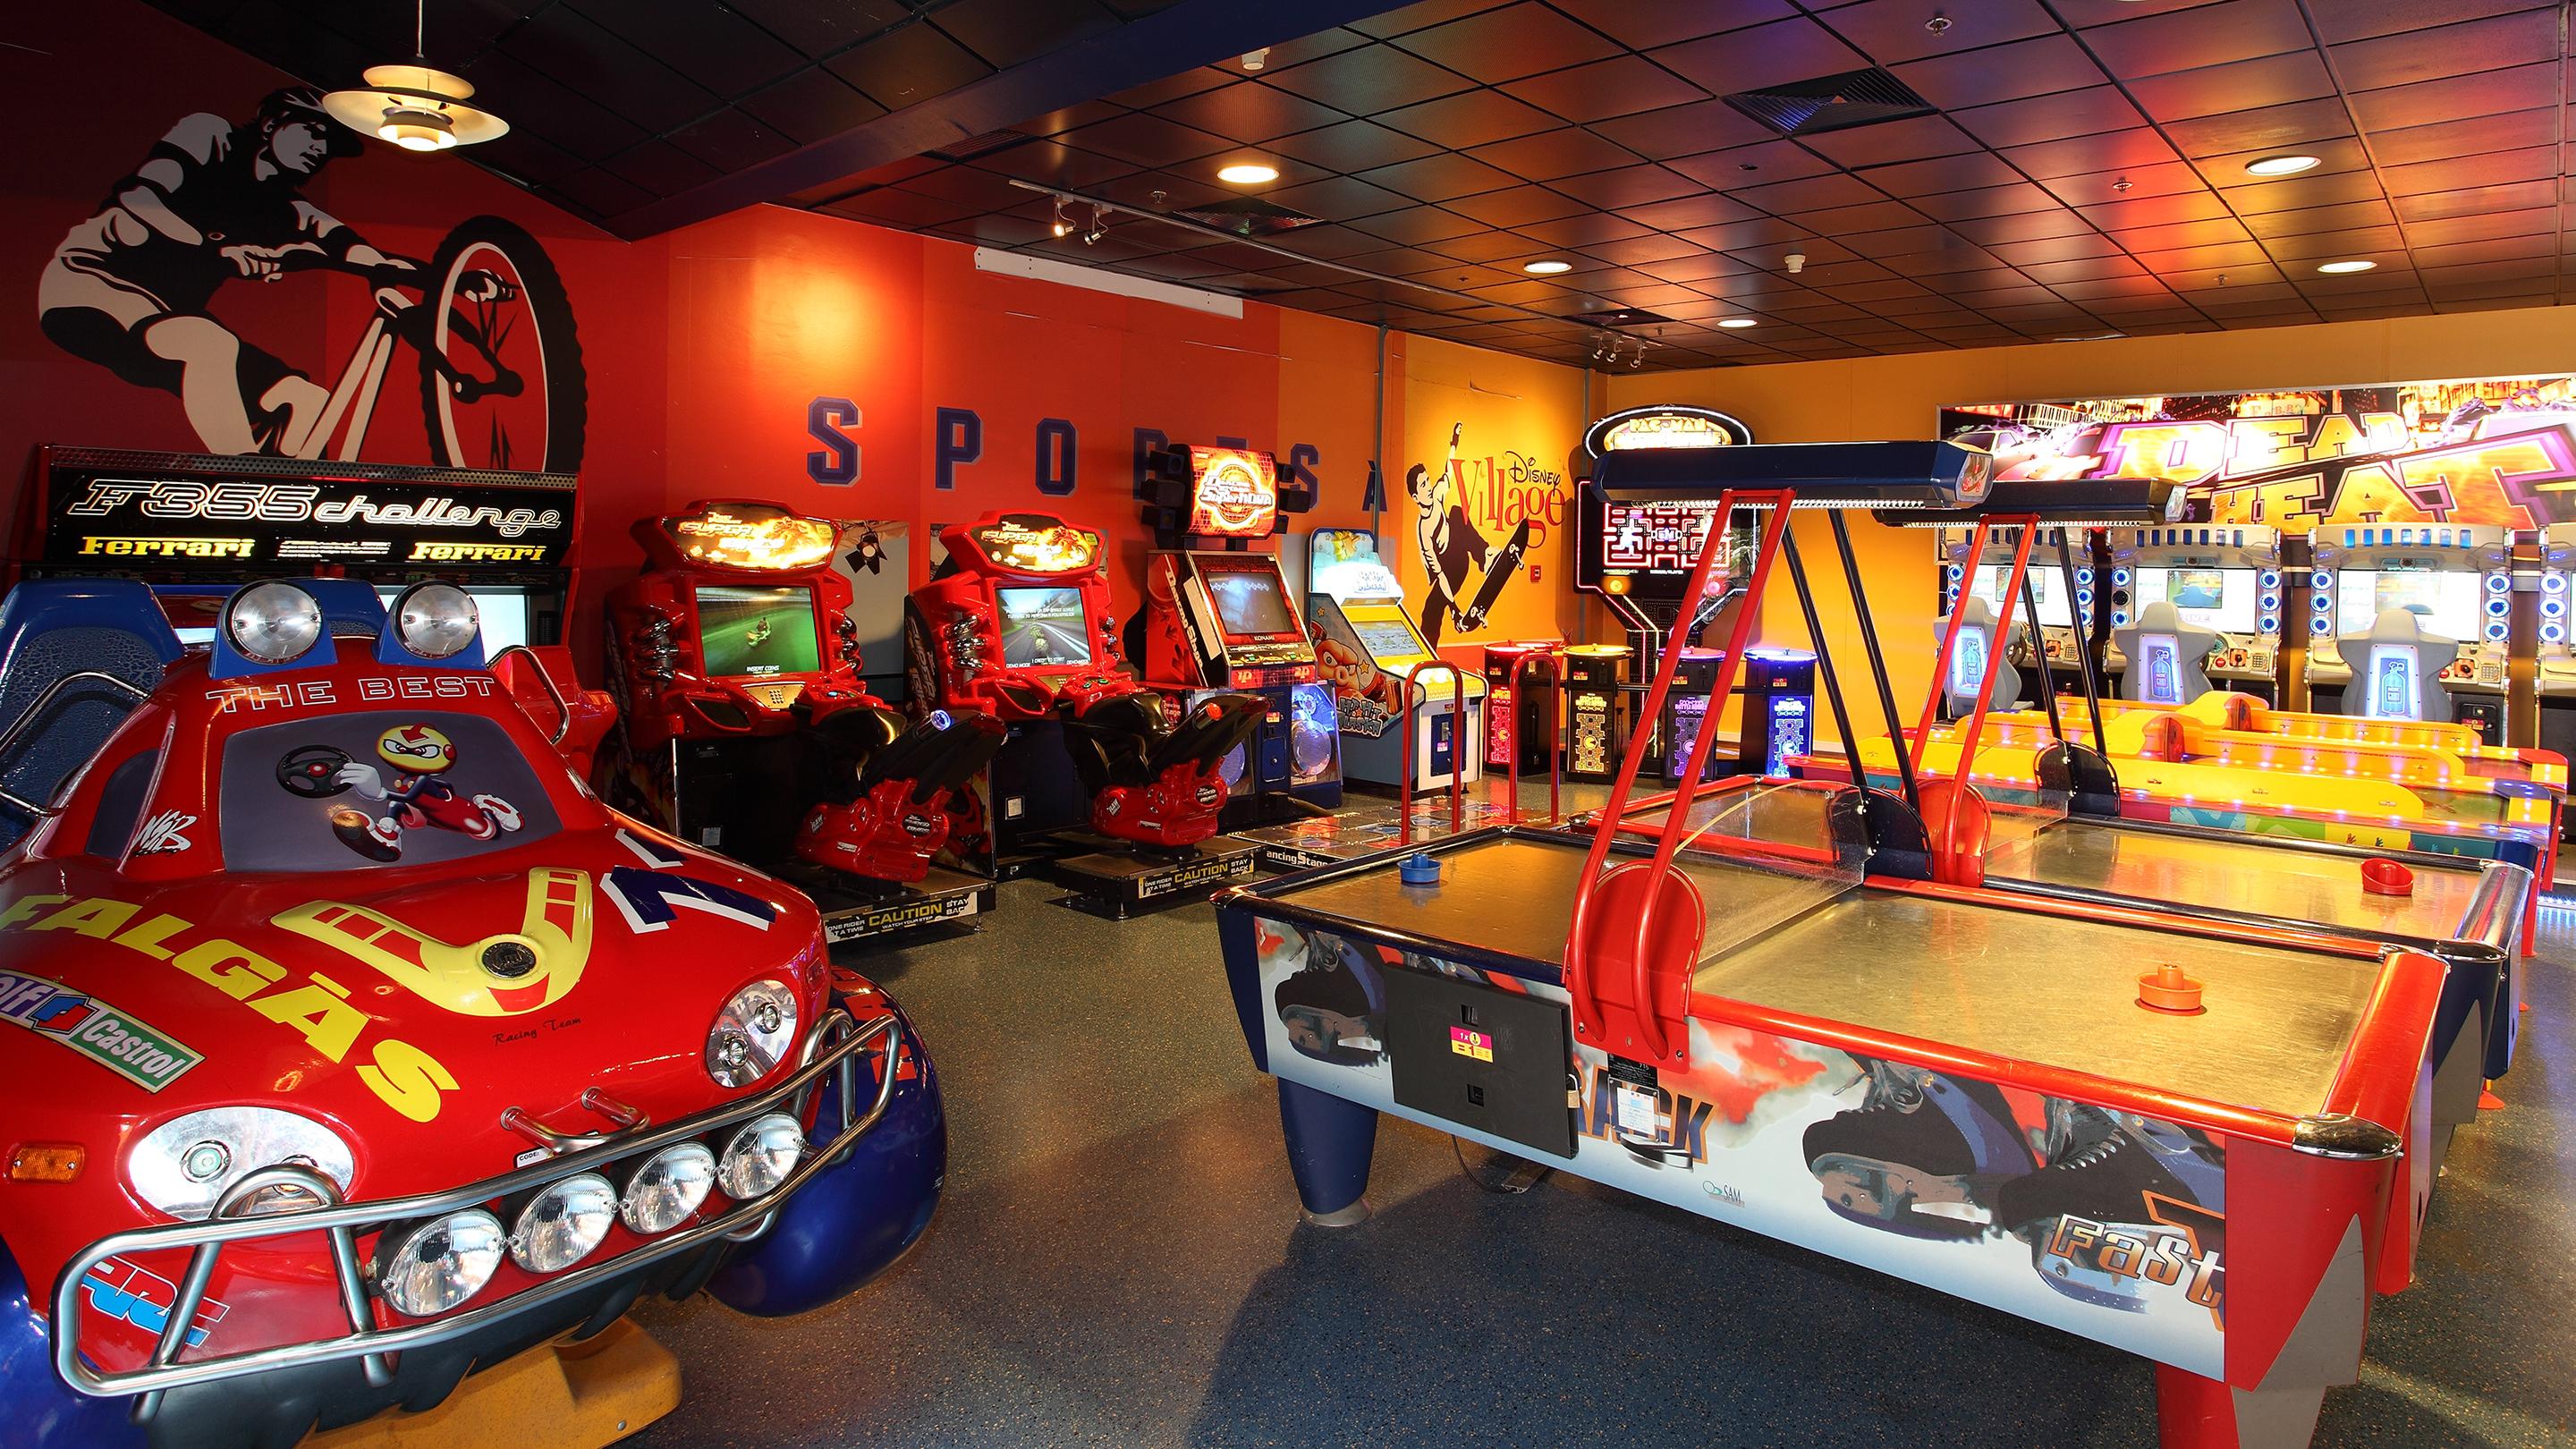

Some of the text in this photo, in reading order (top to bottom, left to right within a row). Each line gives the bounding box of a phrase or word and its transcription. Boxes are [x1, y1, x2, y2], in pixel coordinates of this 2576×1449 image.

[1629, 418, 1707, 432] PAC-MAN
[808, 396, 1320, 512] SPORS
[2100, 412, 2412, 487] DEAD
[1450, 456, 1566, 548] Village
[314, 495, 562, 537] challenge
[79, 537, 257, 557] Ferrari
[408, 542, 547, 562] Ferrari
[205, 676, 496, 714] THE BEST
[1174, 863, 1229, 884] CAUTION
[1231, 859, 1249, 868] STAY
[1231, 865, 1249, 874] BACK
[1156, 877, 1173, 885] RIDER
[946, 898, 970, 908] STAY
[946, 906, 965, 916] BAC
[843, 919, 866, 929] RIDER
[869, 902, 943, 927] CAUTION
[846, 926, 864, 935] TIME
[493, 1017, 582, 1046] Racing Team
[82, 1020, 187, 1079] Castrol
[1724, 1184, 1741, 1203] SAM
[2048, 1213, 2225, 1309] Fast
